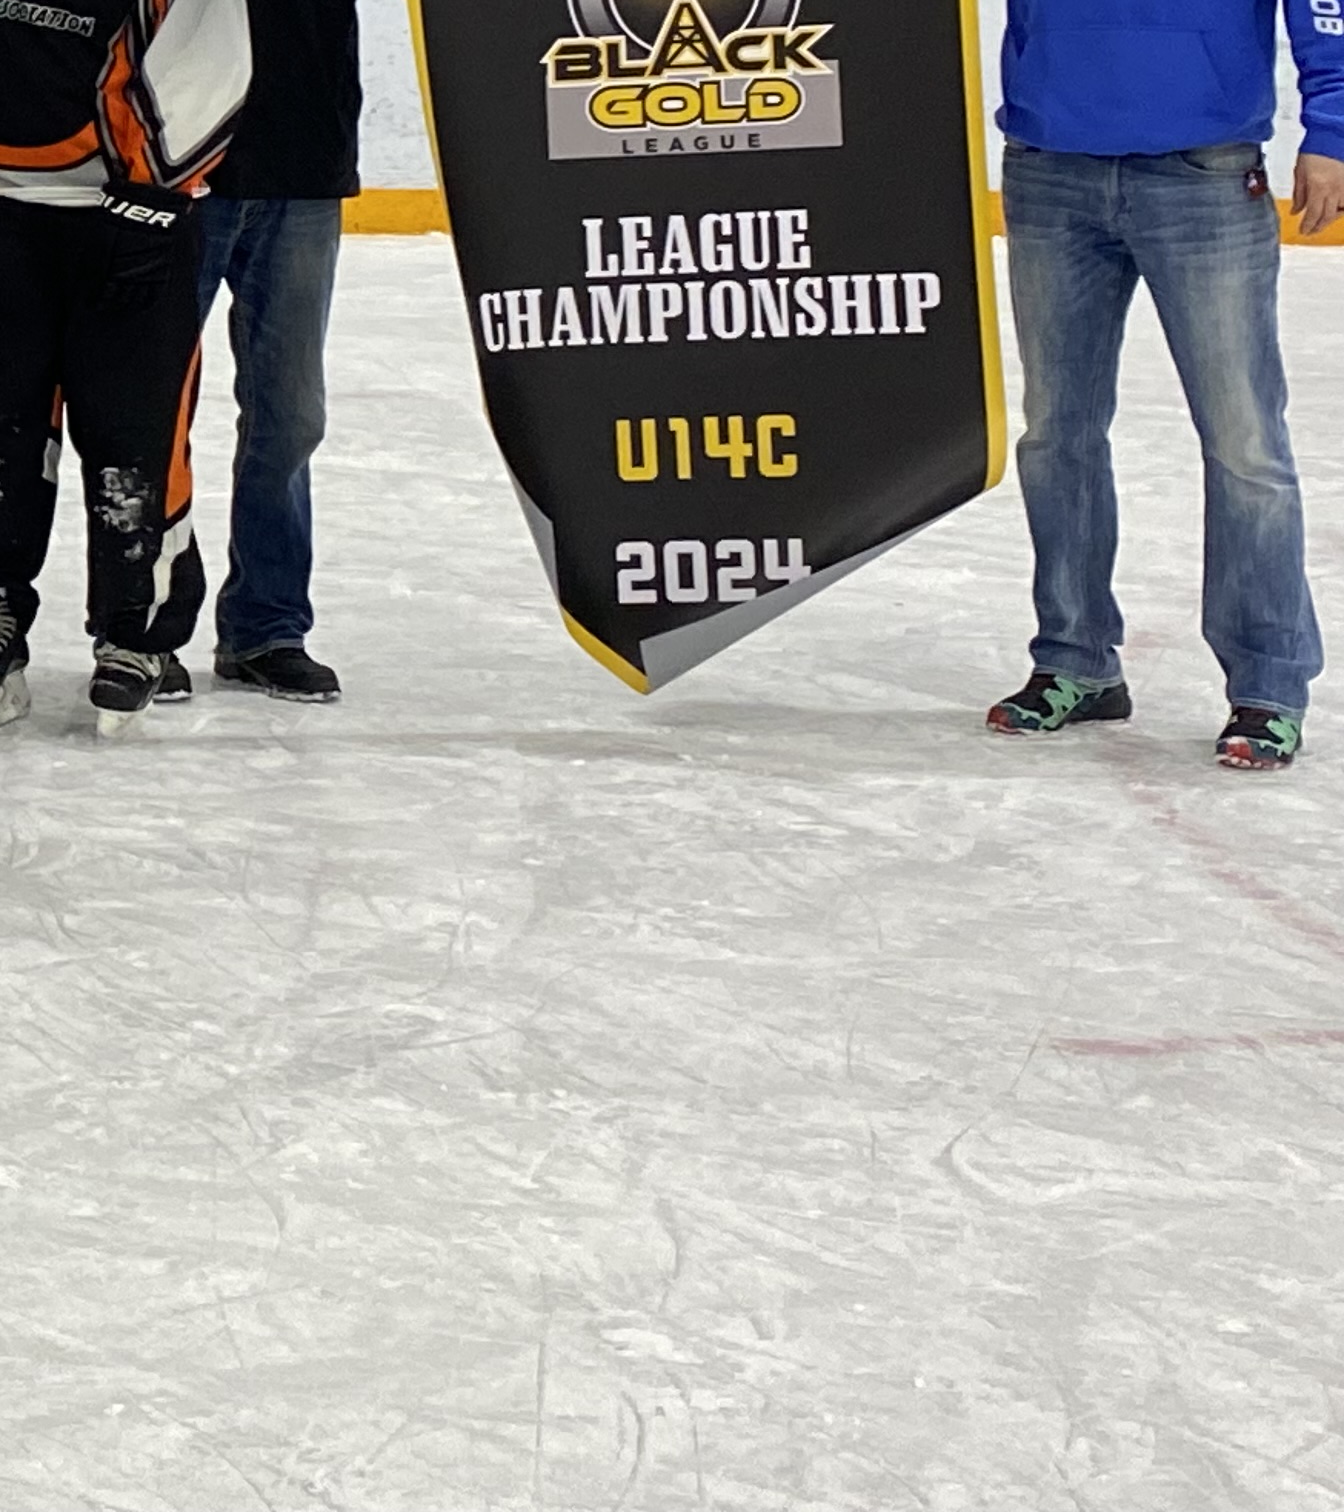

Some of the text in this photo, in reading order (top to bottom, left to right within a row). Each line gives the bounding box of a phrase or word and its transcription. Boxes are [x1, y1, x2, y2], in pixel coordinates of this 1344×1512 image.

[587, 77, 803, 131] GOLD
[621, 133, 762, 155] LEAGUE
[582, 209, 811, 279] LEAGUE
[478, 271, 942, 352] CHAMPIONSHIP
[615, 414, 798, 482] U14C
[616, 538, 812, 603] 2024
